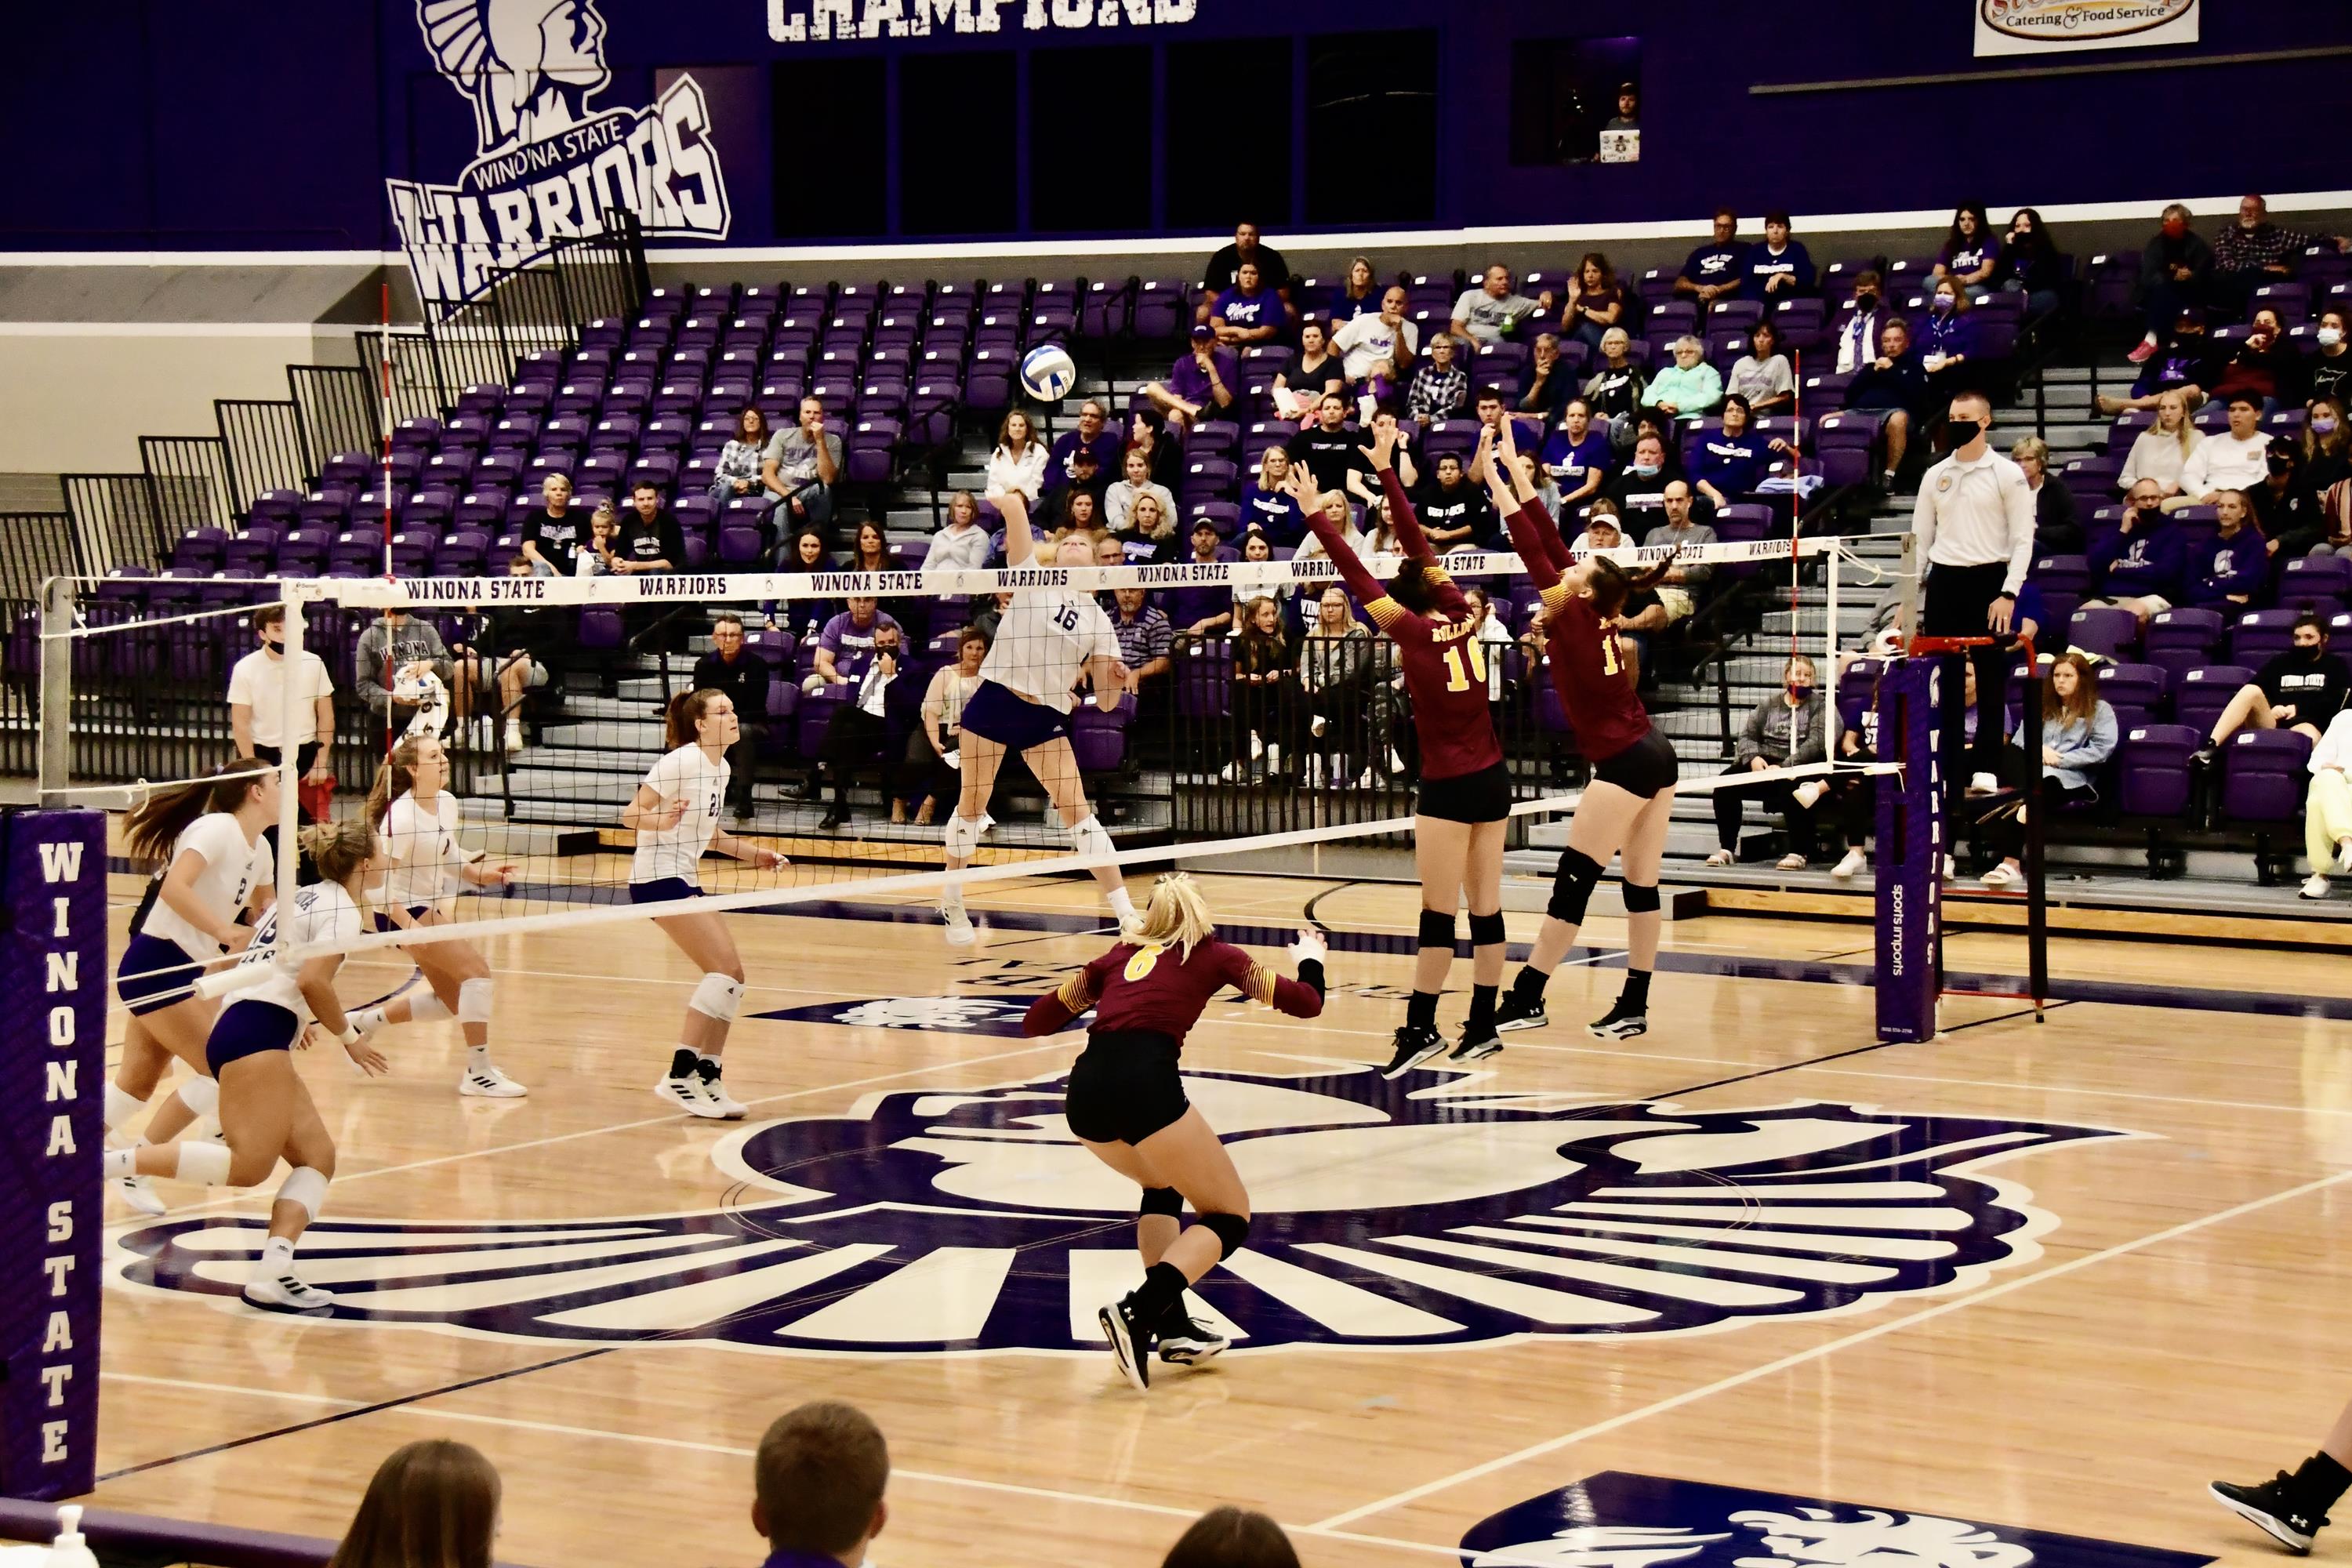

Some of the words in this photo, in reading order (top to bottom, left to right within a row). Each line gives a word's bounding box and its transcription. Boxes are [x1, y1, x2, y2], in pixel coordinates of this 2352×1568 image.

[2006, 14, 2062, 27] Catering
[2063, 6, 2082, 29] &
[2082, 9, 2114, 23] Food
[2117, 5, 2165, 20] Service
[472, 141, 562, 191] WINONA
[565, 117, 624, 159] STATE
[390, 80, 724, 303] WARRIORS
[1676, 546, 1704, 560] STATE
[1749, 540, 1792, 557] WARRIORS
[1137, 566, 1188, 583] WINONA
[1192, 564, 1229, 580] STATE
[1291, 560, 1343, 578] WARRIO
[1453, 556, 1486, 571] STATE
[640, 576, 727, 596] WARRIORS
[811, 574, 871, 591] WINONA
[879, 572, 923, 590] STATE
[997, 569, 1068, 587] WARRIORS
[405, 580, 481, 600] WINONA
[491, 580, 545, 599] STATE
[1054, 604, 1079, 631] 16
[1891, 884, 1904, 925] sports
[1890, 925, 1904, 976] imports
[1124, 945, 1165, 982] 6
[39, 841, 84, 1156] WINONA
[42, 1200, 75, 1464] STATE
